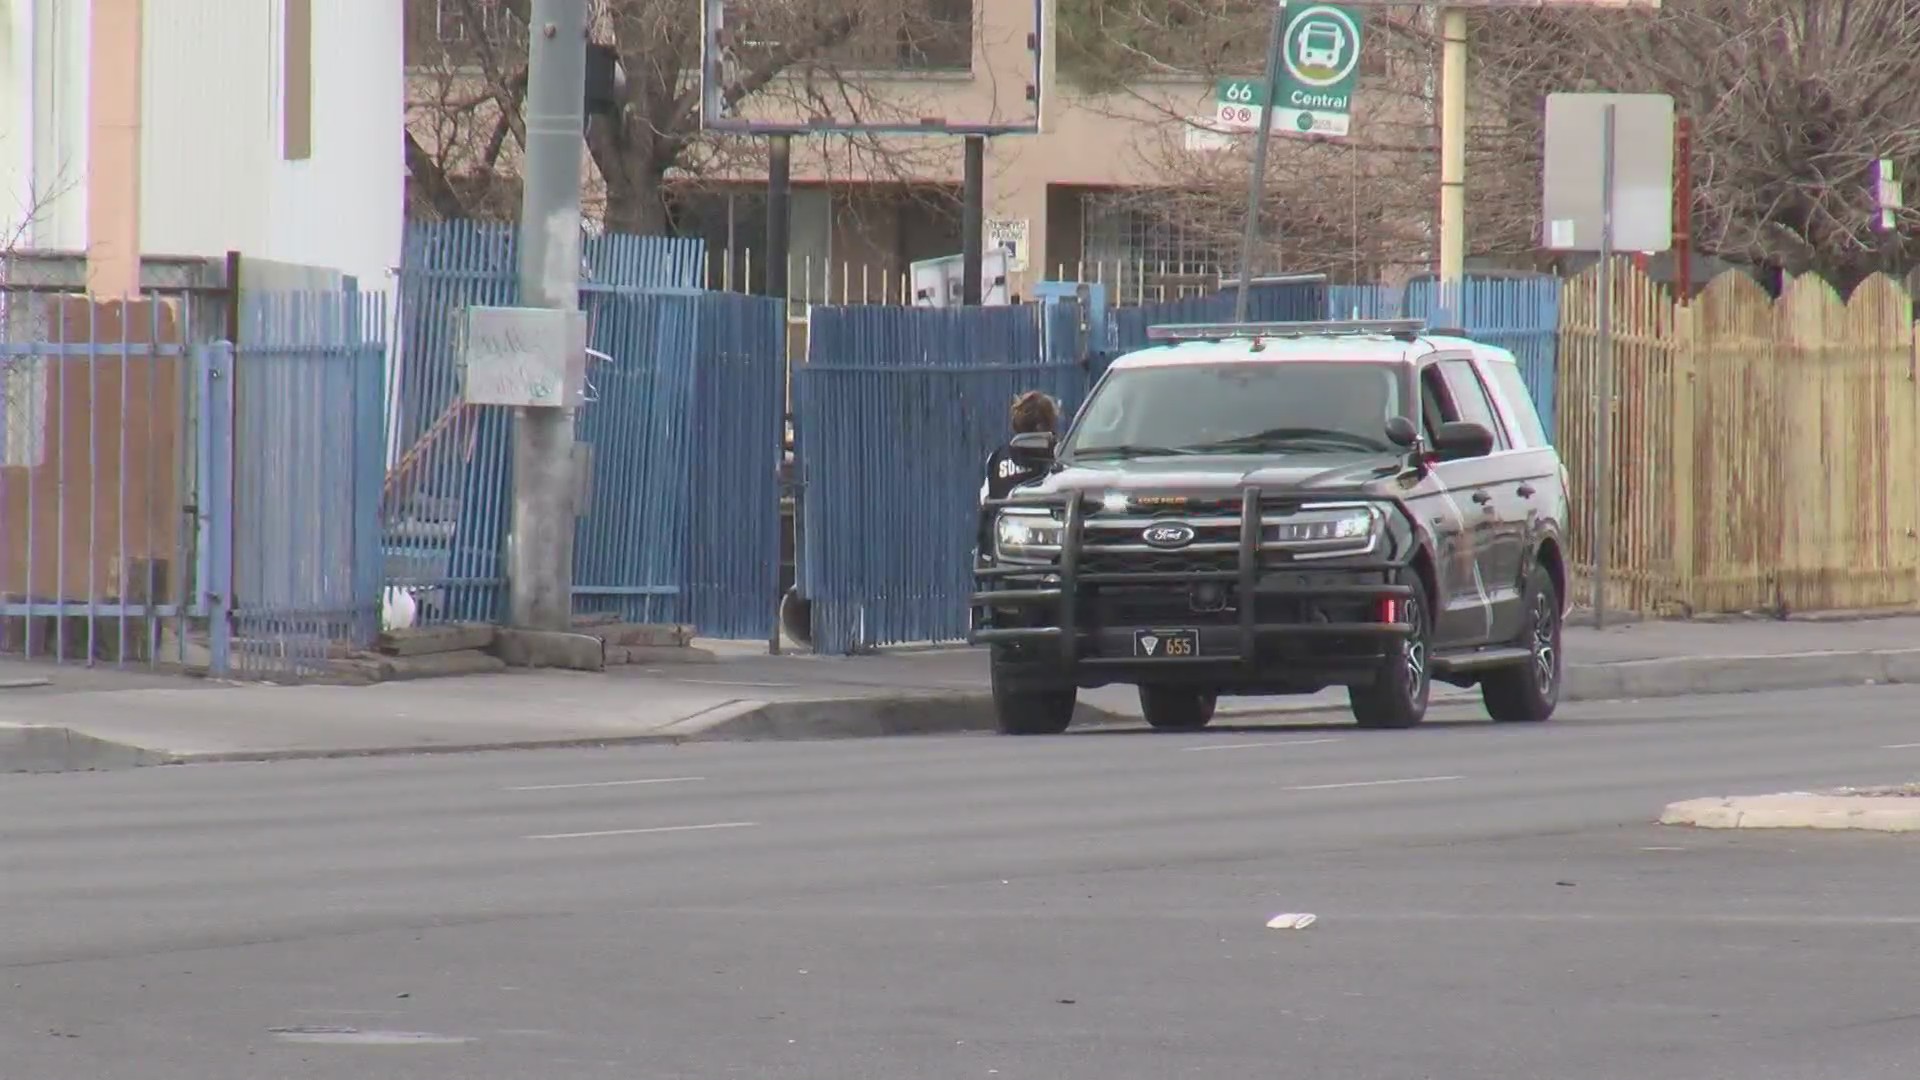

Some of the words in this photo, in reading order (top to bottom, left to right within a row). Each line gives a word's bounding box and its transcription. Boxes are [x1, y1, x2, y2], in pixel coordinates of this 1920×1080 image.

[1227, 83, 1252, 101] 66
[1291, 90, 1348, 109] Central
[1154, 527, 1183, 541] Ford
[1166, 638, 1192, 655] 655
